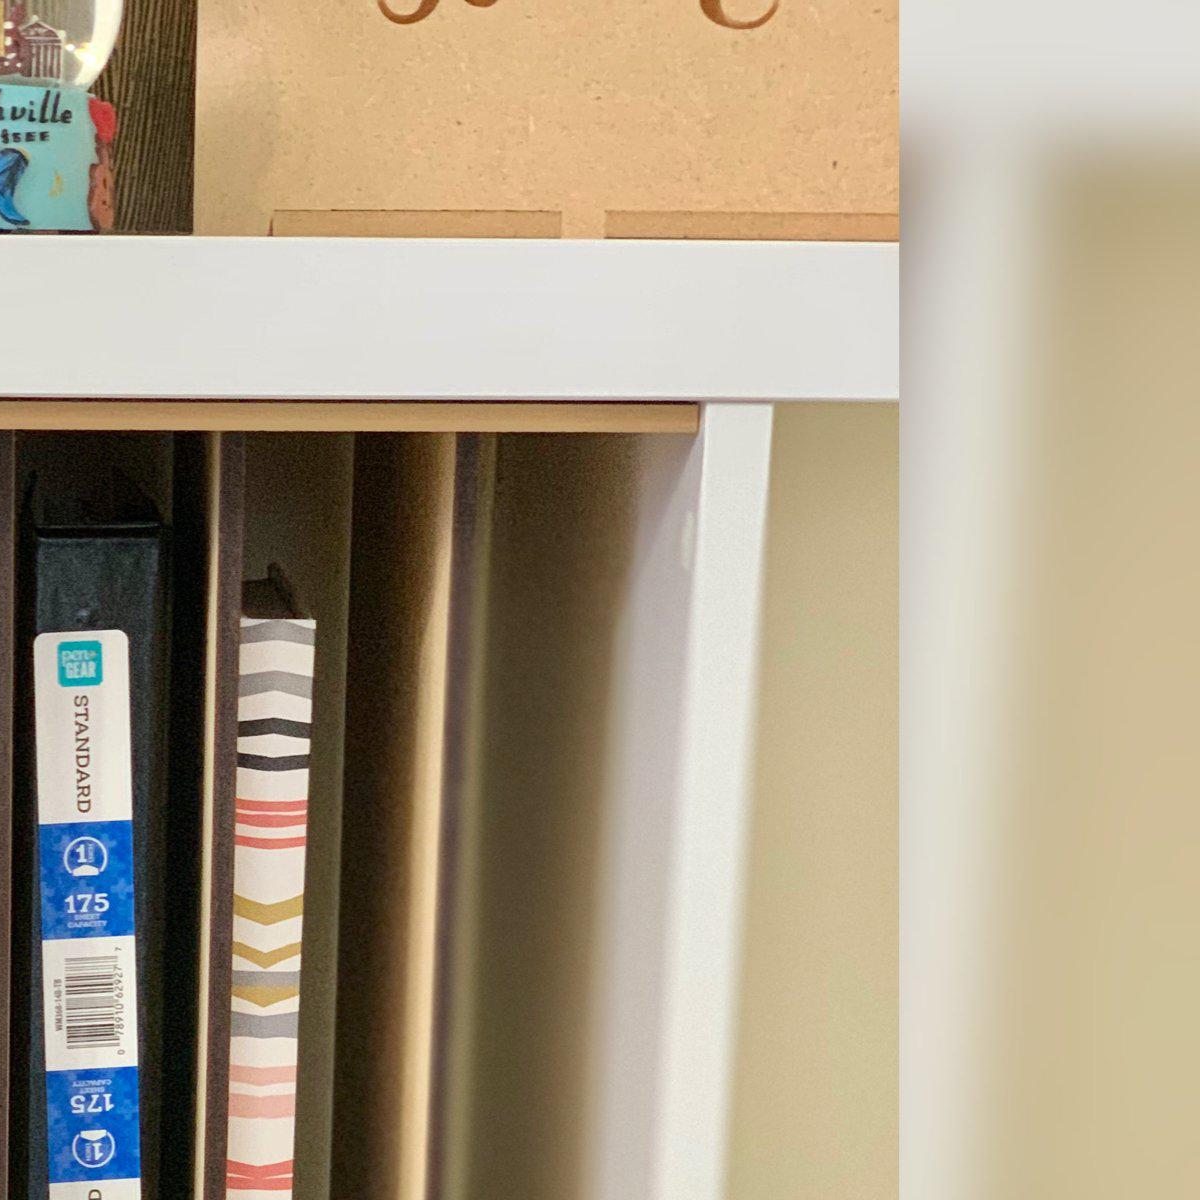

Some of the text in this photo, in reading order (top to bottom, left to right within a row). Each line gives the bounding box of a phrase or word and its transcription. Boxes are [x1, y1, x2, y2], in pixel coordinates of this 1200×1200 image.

[65, 661, 97, 679] GEAR
[74, 695, 91, 813] STANDARD
[64, 893, 110, 913] 175
[70, 1093, 115, 1114] 175
